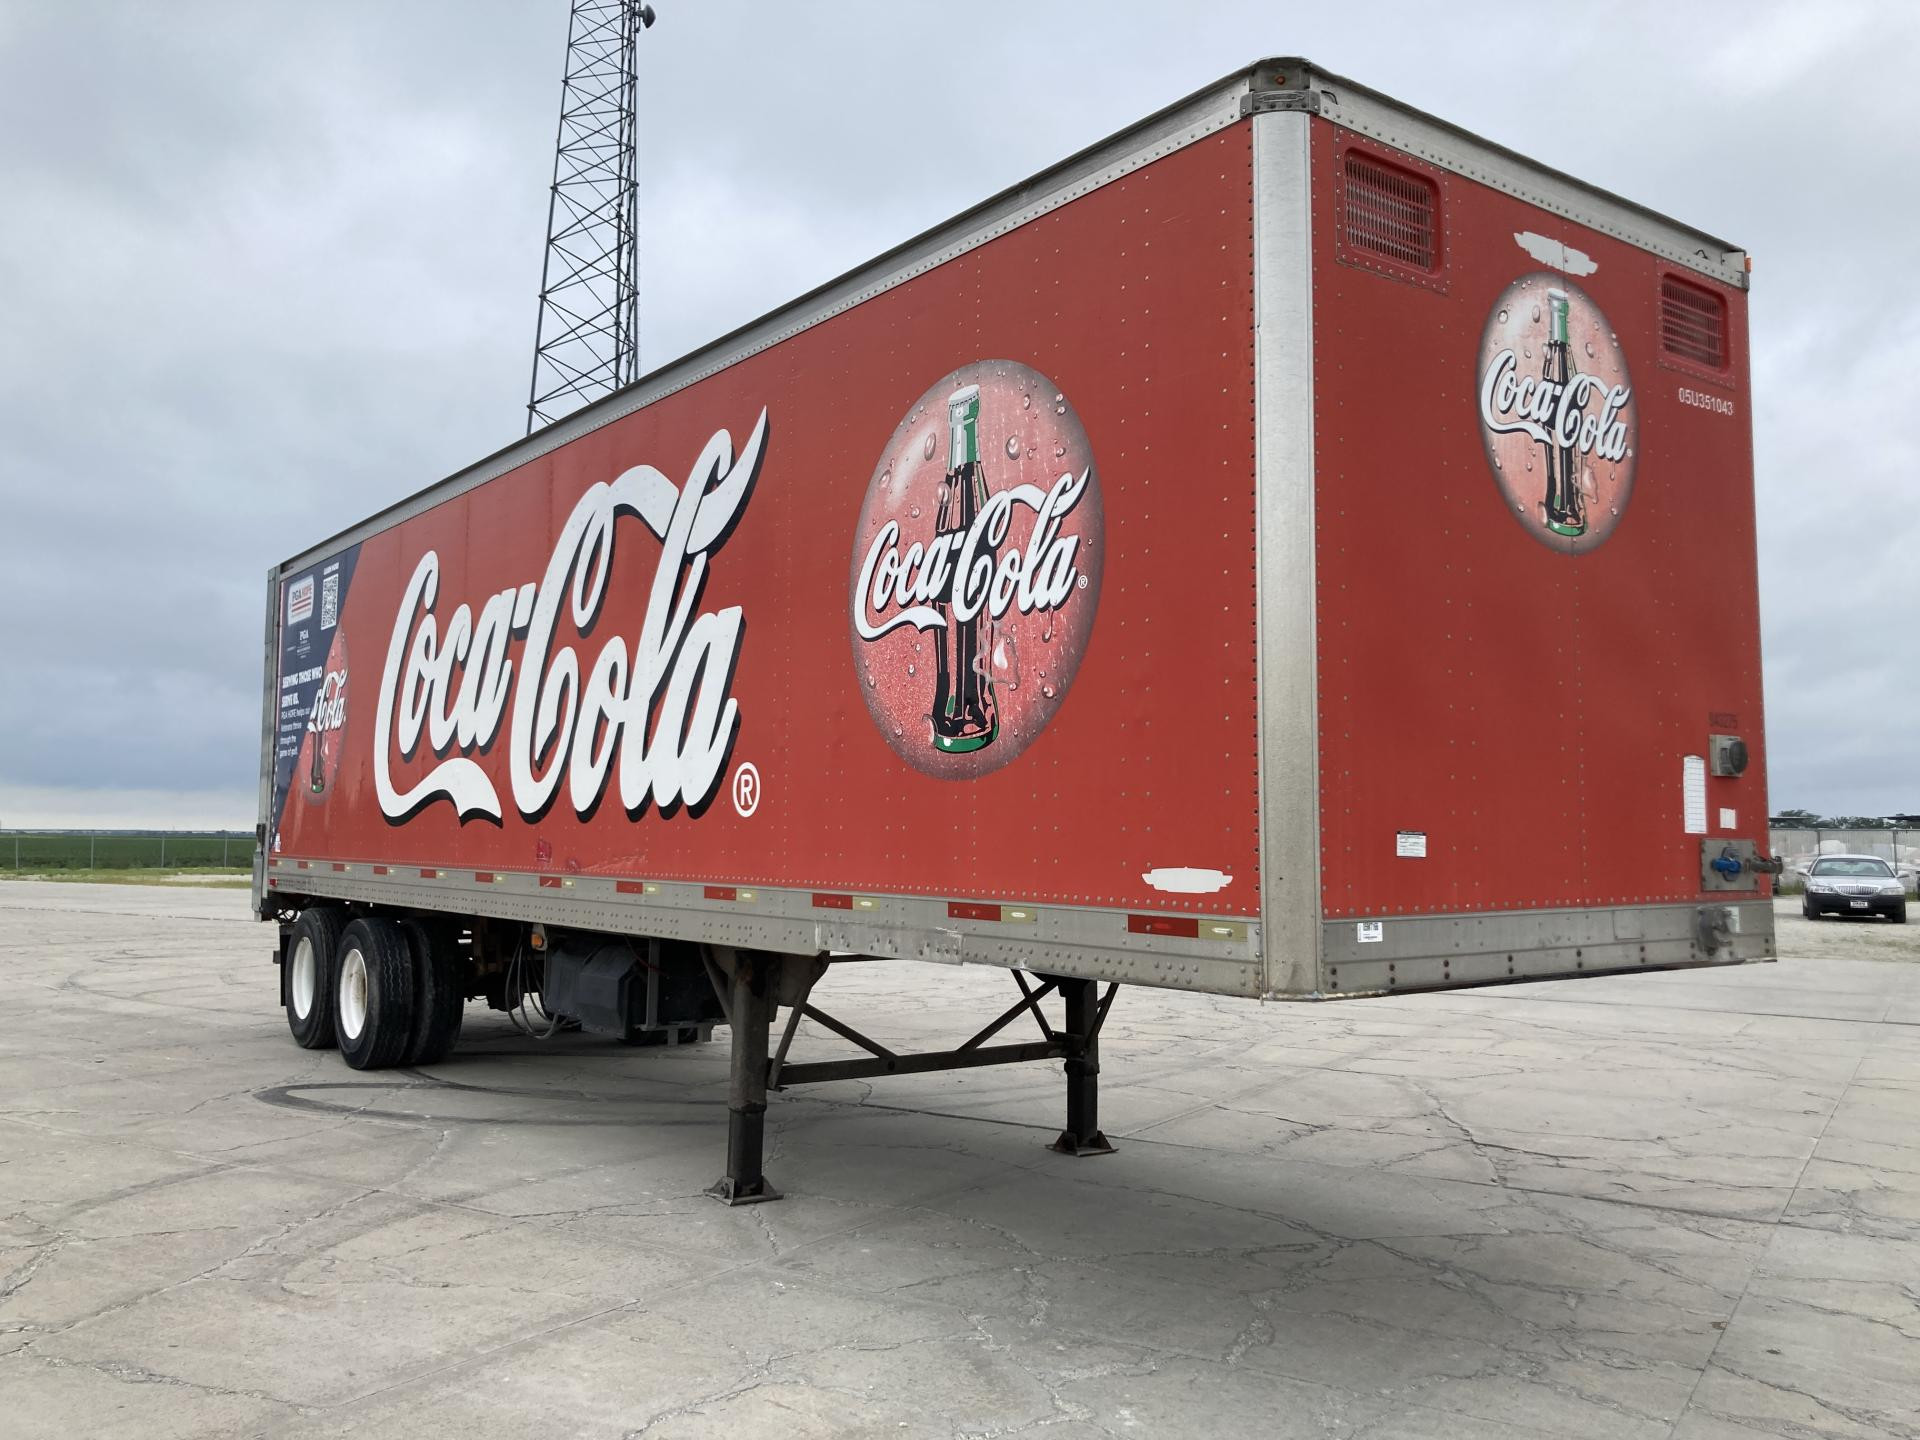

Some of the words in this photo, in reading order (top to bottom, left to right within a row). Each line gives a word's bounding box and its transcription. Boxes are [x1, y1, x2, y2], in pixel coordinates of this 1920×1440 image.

[1480, 348, 1630, 463] Coca-Cola
[1678, 387, 1734, 416] 05U351043
[374, 404, 768, 822] Coca-Cola
[854, 465, 1090, 640] Coca-Cola
